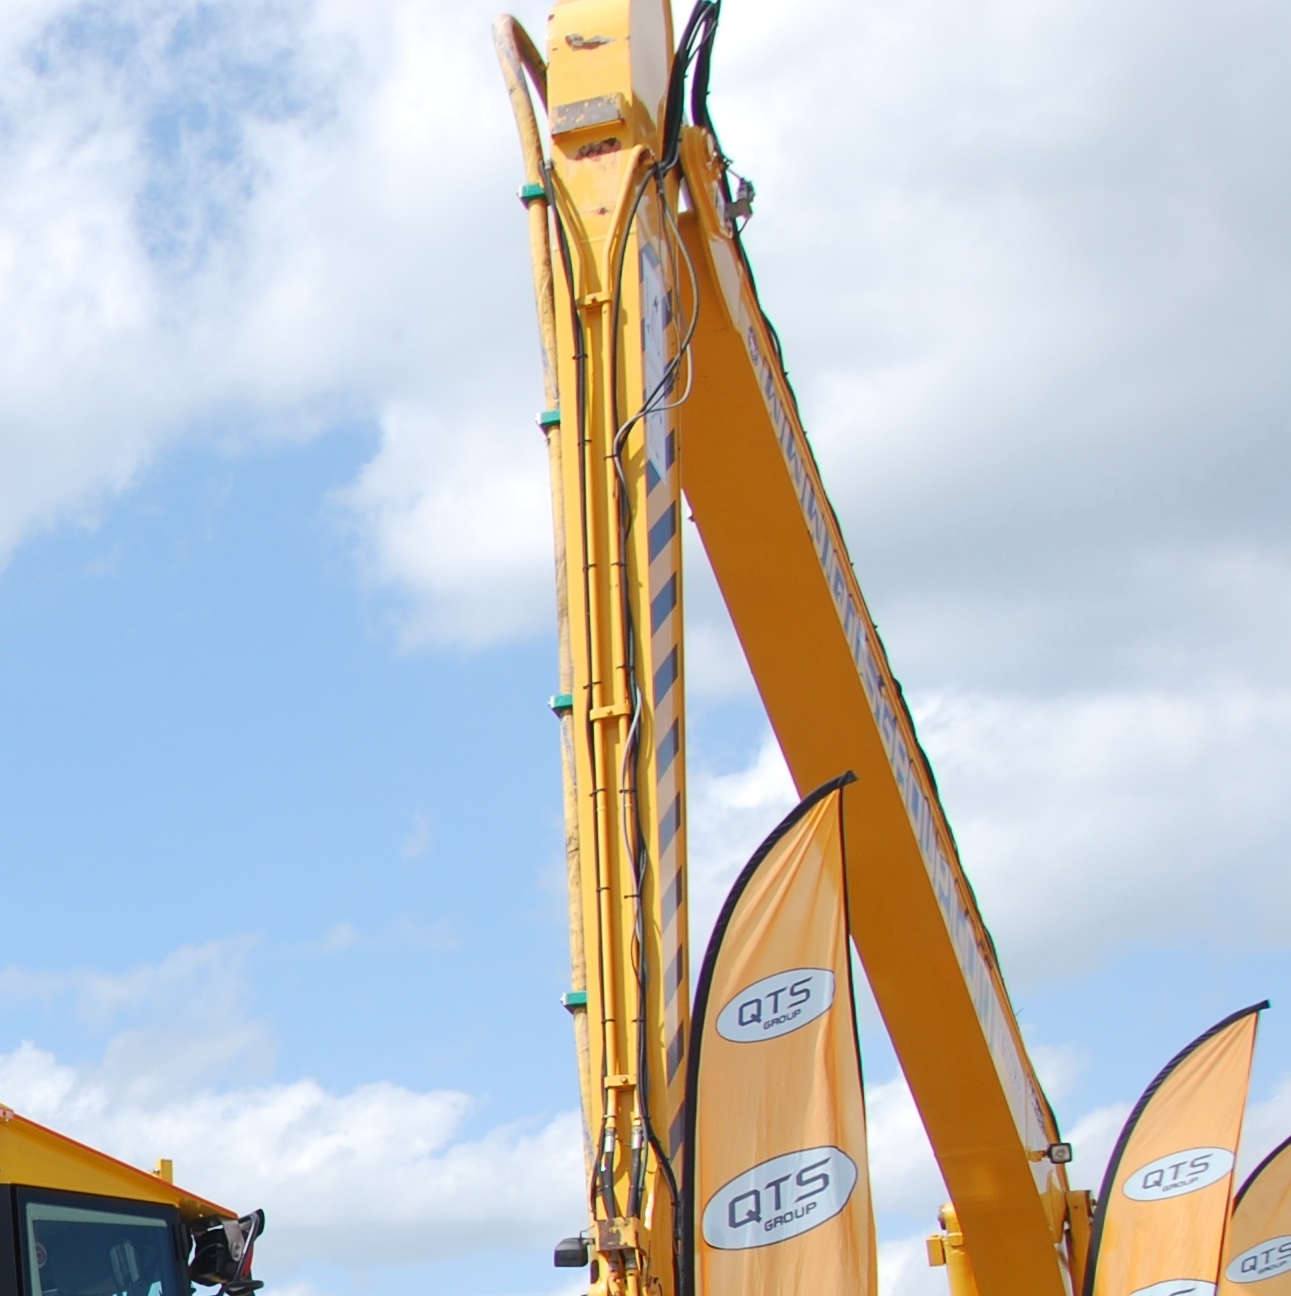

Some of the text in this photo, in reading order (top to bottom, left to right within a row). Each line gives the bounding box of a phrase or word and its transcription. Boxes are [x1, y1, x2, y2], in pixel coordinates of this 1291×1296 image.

[738, 976, 813, 1027] QTS
[763, 1008, 801, 1030] GROUP
[1142, 1153, 1213, 1189] QTS
[1162, 1177, 1199, 1192] GROUP
[728, 1156, 831, 1229] QTS
[764, 1201, 817, 1232] GROUP
[1241, 1242, 1291, 1273] QTS
[1257, 1260, 1287, 1274] GROUP
